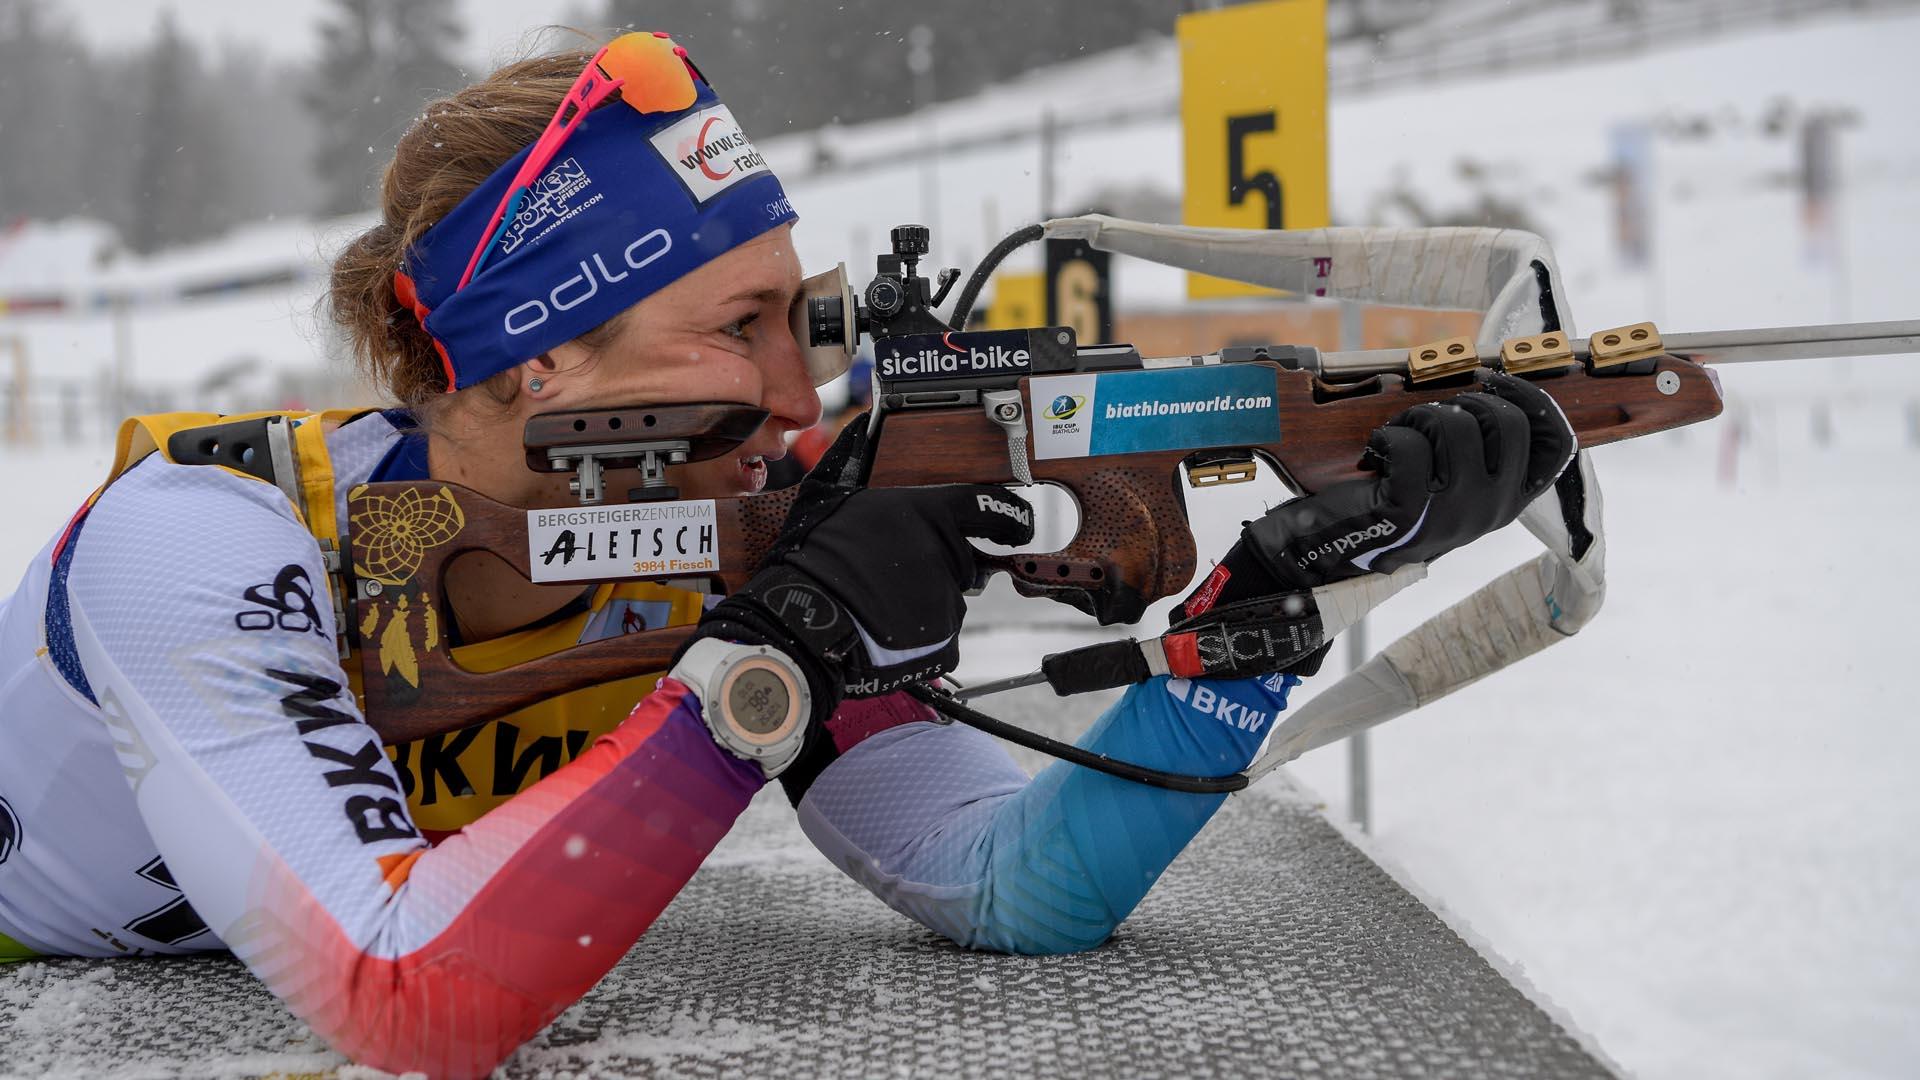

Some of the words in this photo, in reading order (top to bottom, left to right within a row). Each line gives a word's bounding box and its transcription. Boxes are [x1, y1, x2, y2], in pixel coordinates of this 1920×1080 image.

[1226, 110, 1284, 230] 5
[561, 177, 592, 202] FIESCH
[504, 228, 672, 334] odlo
[882, 346, 1030, 376] sicilia-bike
[1105, 394, 1272, 420] biathlonworld.com
[538, 504, 711, 527] BERGSTEIGERZENTRUM
[539, 524, 713, 566] ALETSCH
[633, 560, 665, 573] 3984
[669, 558, 713, 571] Fiesch
[1191, 685, 1266, 734] BKW
[265, 667, 417, 844] BKW
